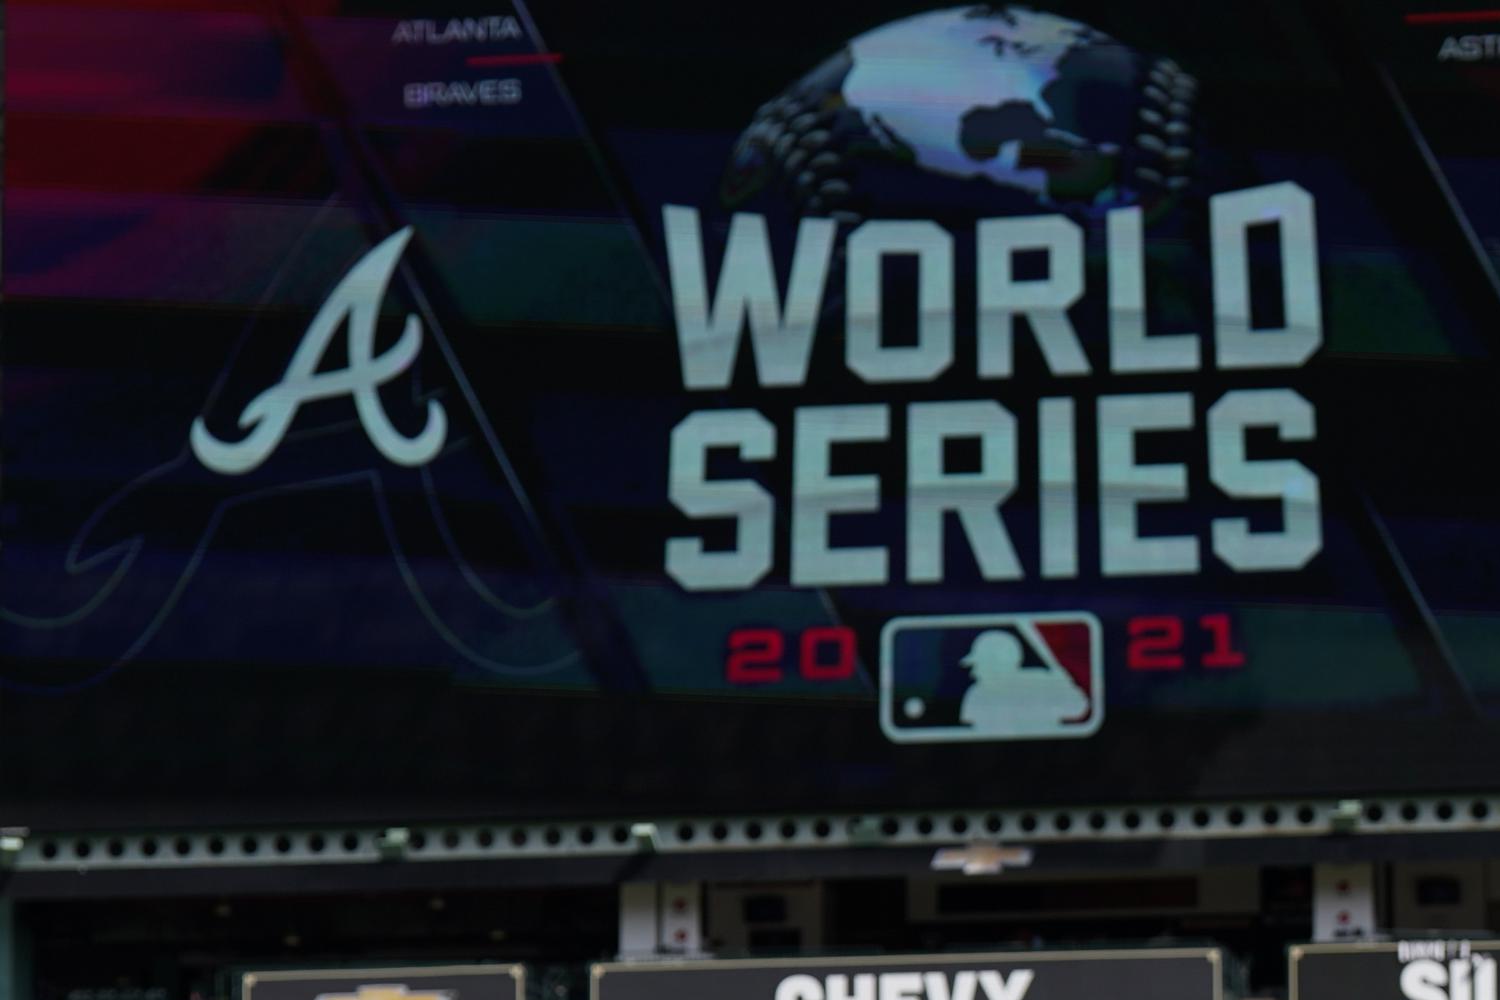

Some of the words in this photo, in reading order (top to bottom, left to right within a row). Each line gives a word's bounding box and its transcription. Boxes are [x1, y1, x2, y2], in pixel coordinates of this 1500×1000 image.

[391, 15, 522, 45] ATLANTA
[403, 77, 522, 108] BRAVES
[662, 180, 1324, 390] WORLD
[665, 387, 1324, 591] SERIES
[726, 626, 858, 683] 20
[1127, 614, 1245, 669] 21
